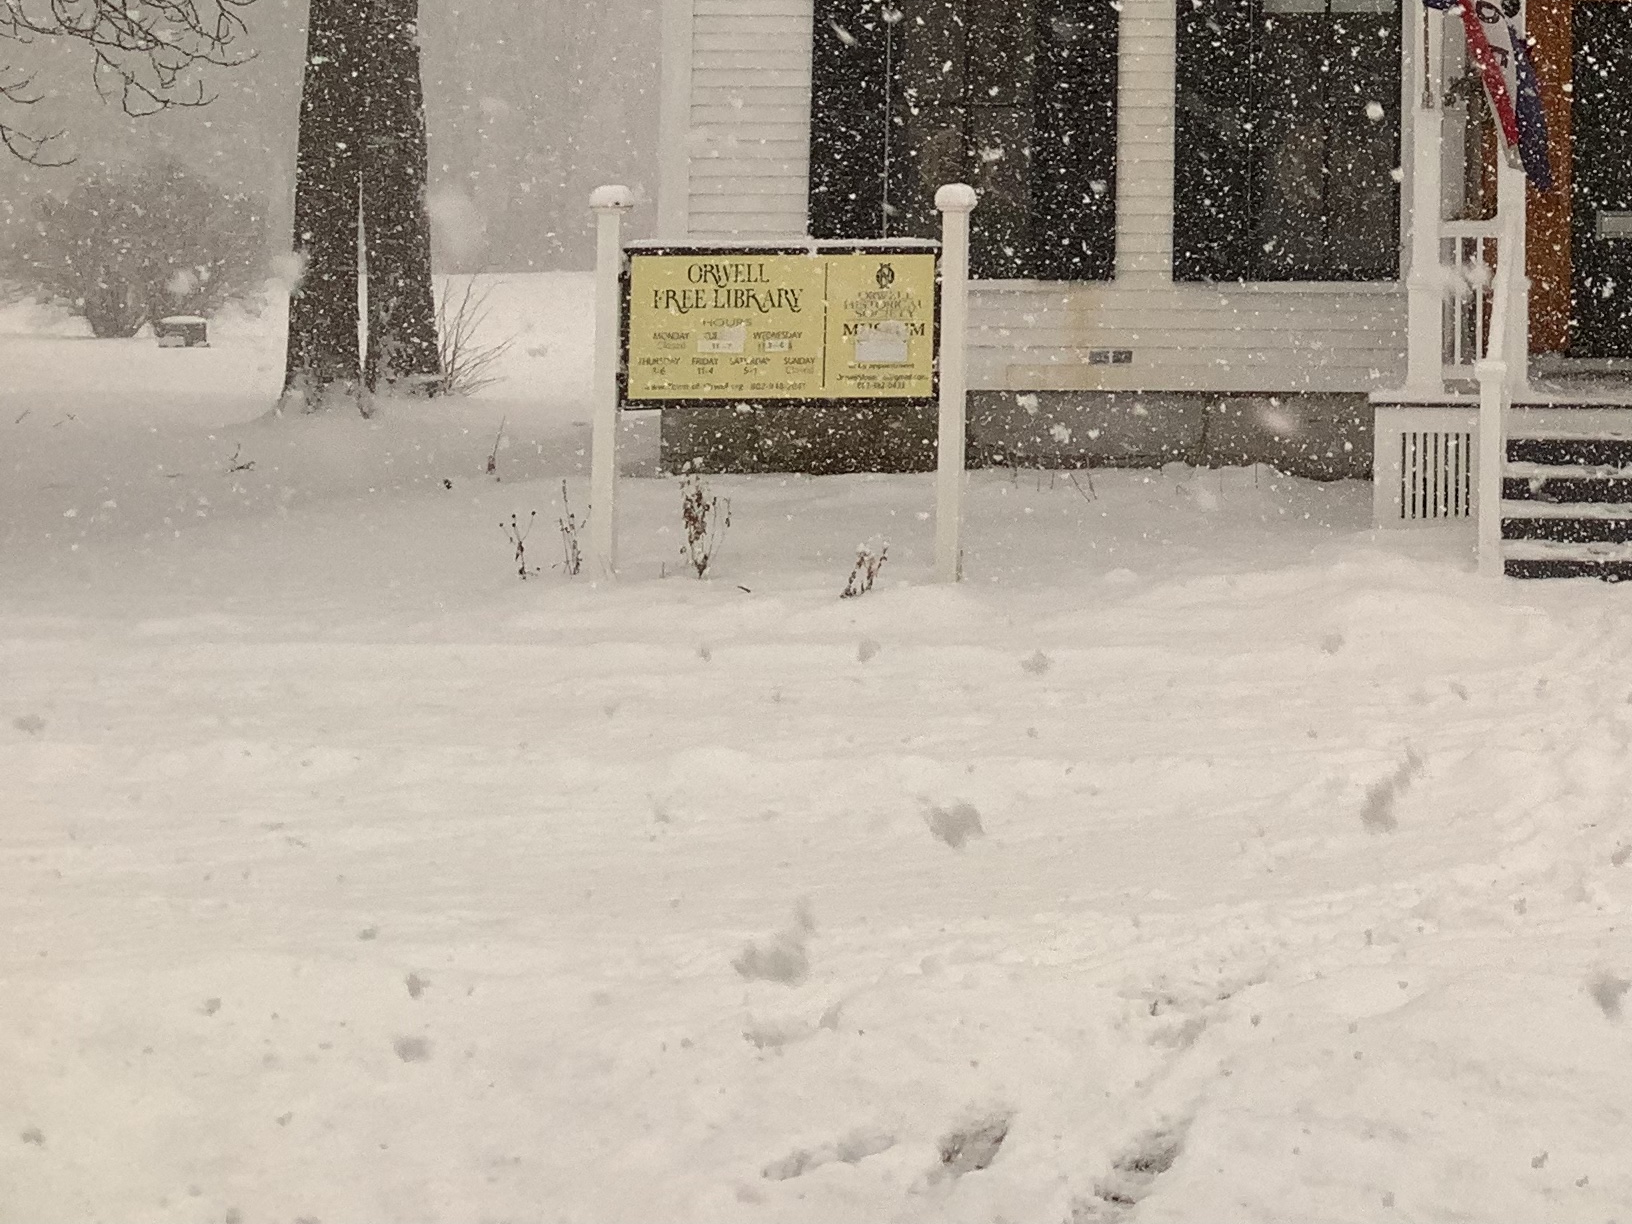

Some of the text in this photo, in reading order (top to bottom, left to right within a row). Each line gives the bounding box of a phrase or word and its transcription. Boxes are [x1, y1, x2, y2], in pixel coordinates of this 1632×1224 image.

[688, 263, 769, 288] ORWELL
[653, 288, 803, 314] FREE LIBRARY
[703, 318, 752, 327] HOURS
[653, 332, 690, 340] MONDAY
[753, 332, 802, 340] WEDNESDAY
[638, 357, 681, 365] THURSDAY
[691, 357, 719, 365] FRIDAY
[783, 357, 816, 365] SUNDAY
